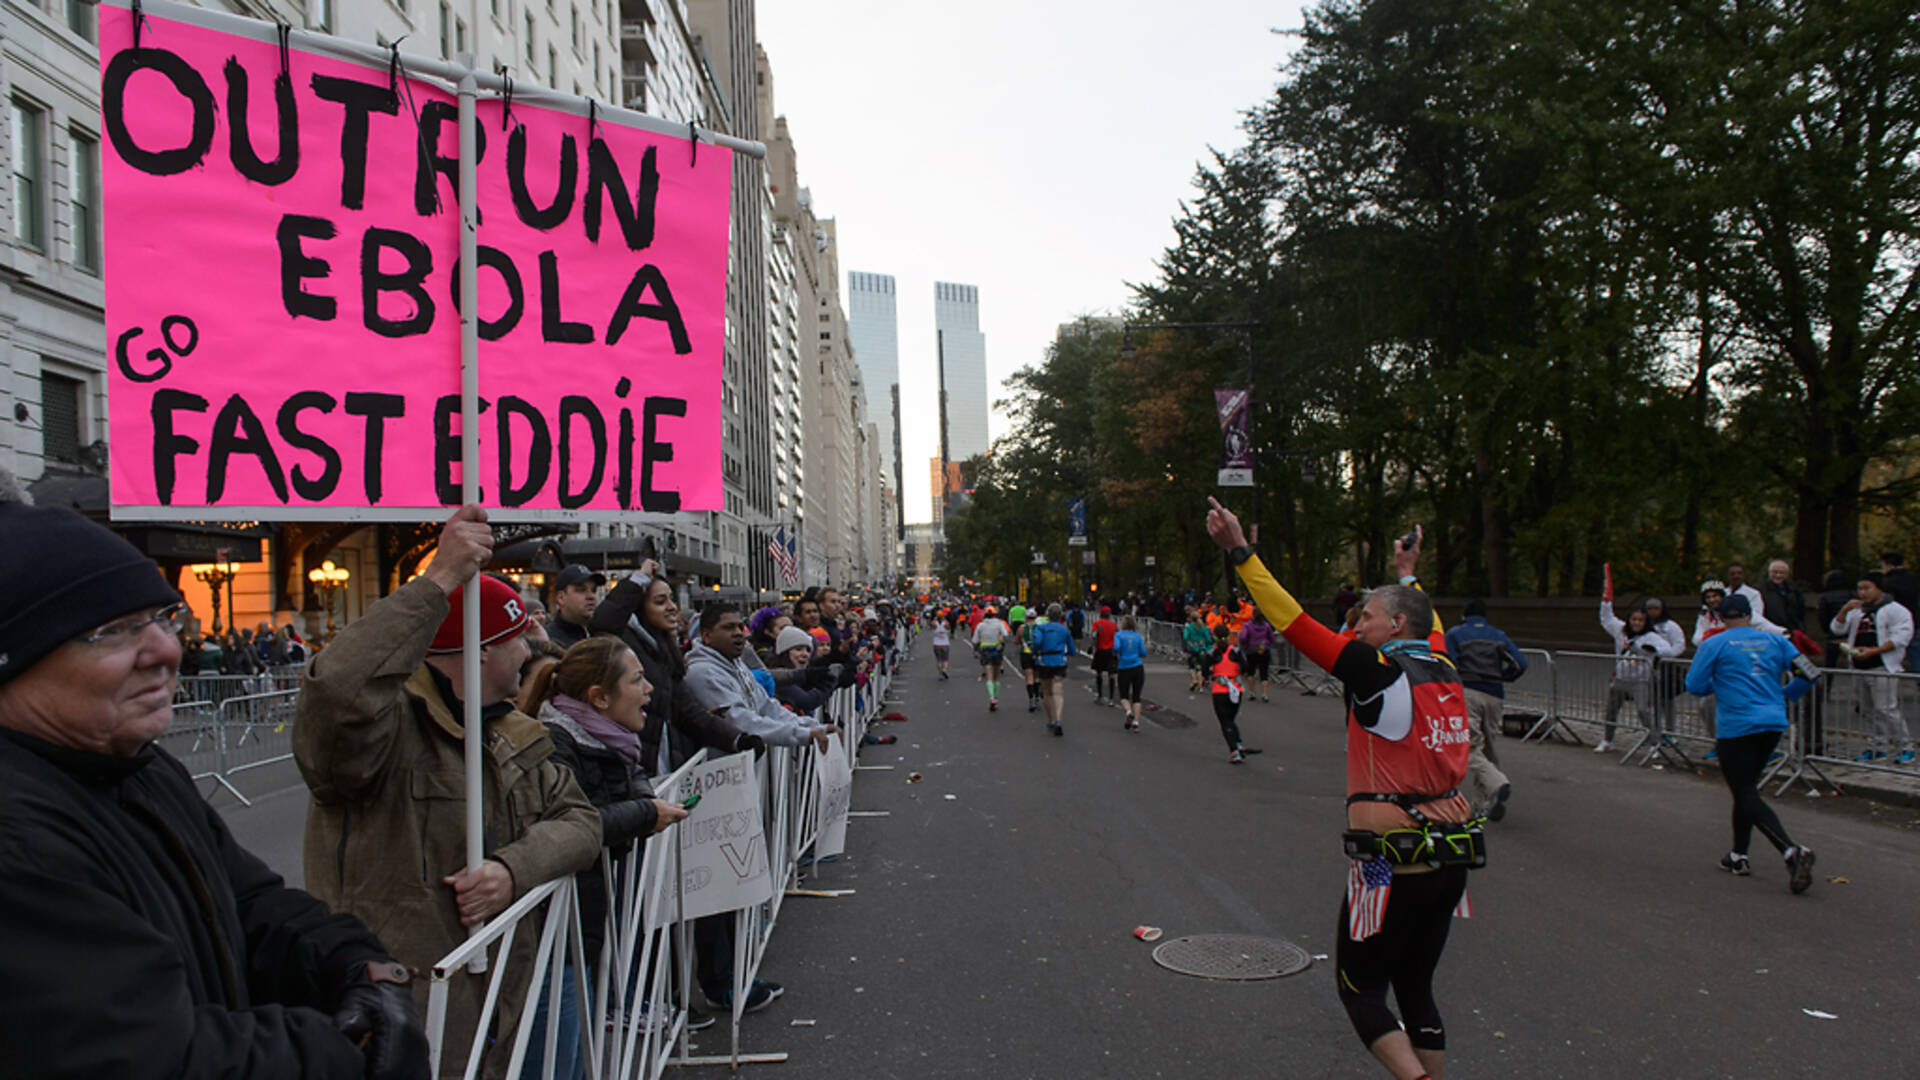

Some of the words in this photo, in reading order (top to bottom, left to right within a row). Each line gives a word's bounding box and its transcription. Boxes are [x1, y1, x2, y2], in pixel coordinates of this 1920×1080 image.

[102, 47, 658, 251] OUTRUN
[276, 213, 692, 355] EBOLA
[116, 315, 199, 382] GO
[151, 388, 405, 506] FAST
[503, 599, 523, 622] R
